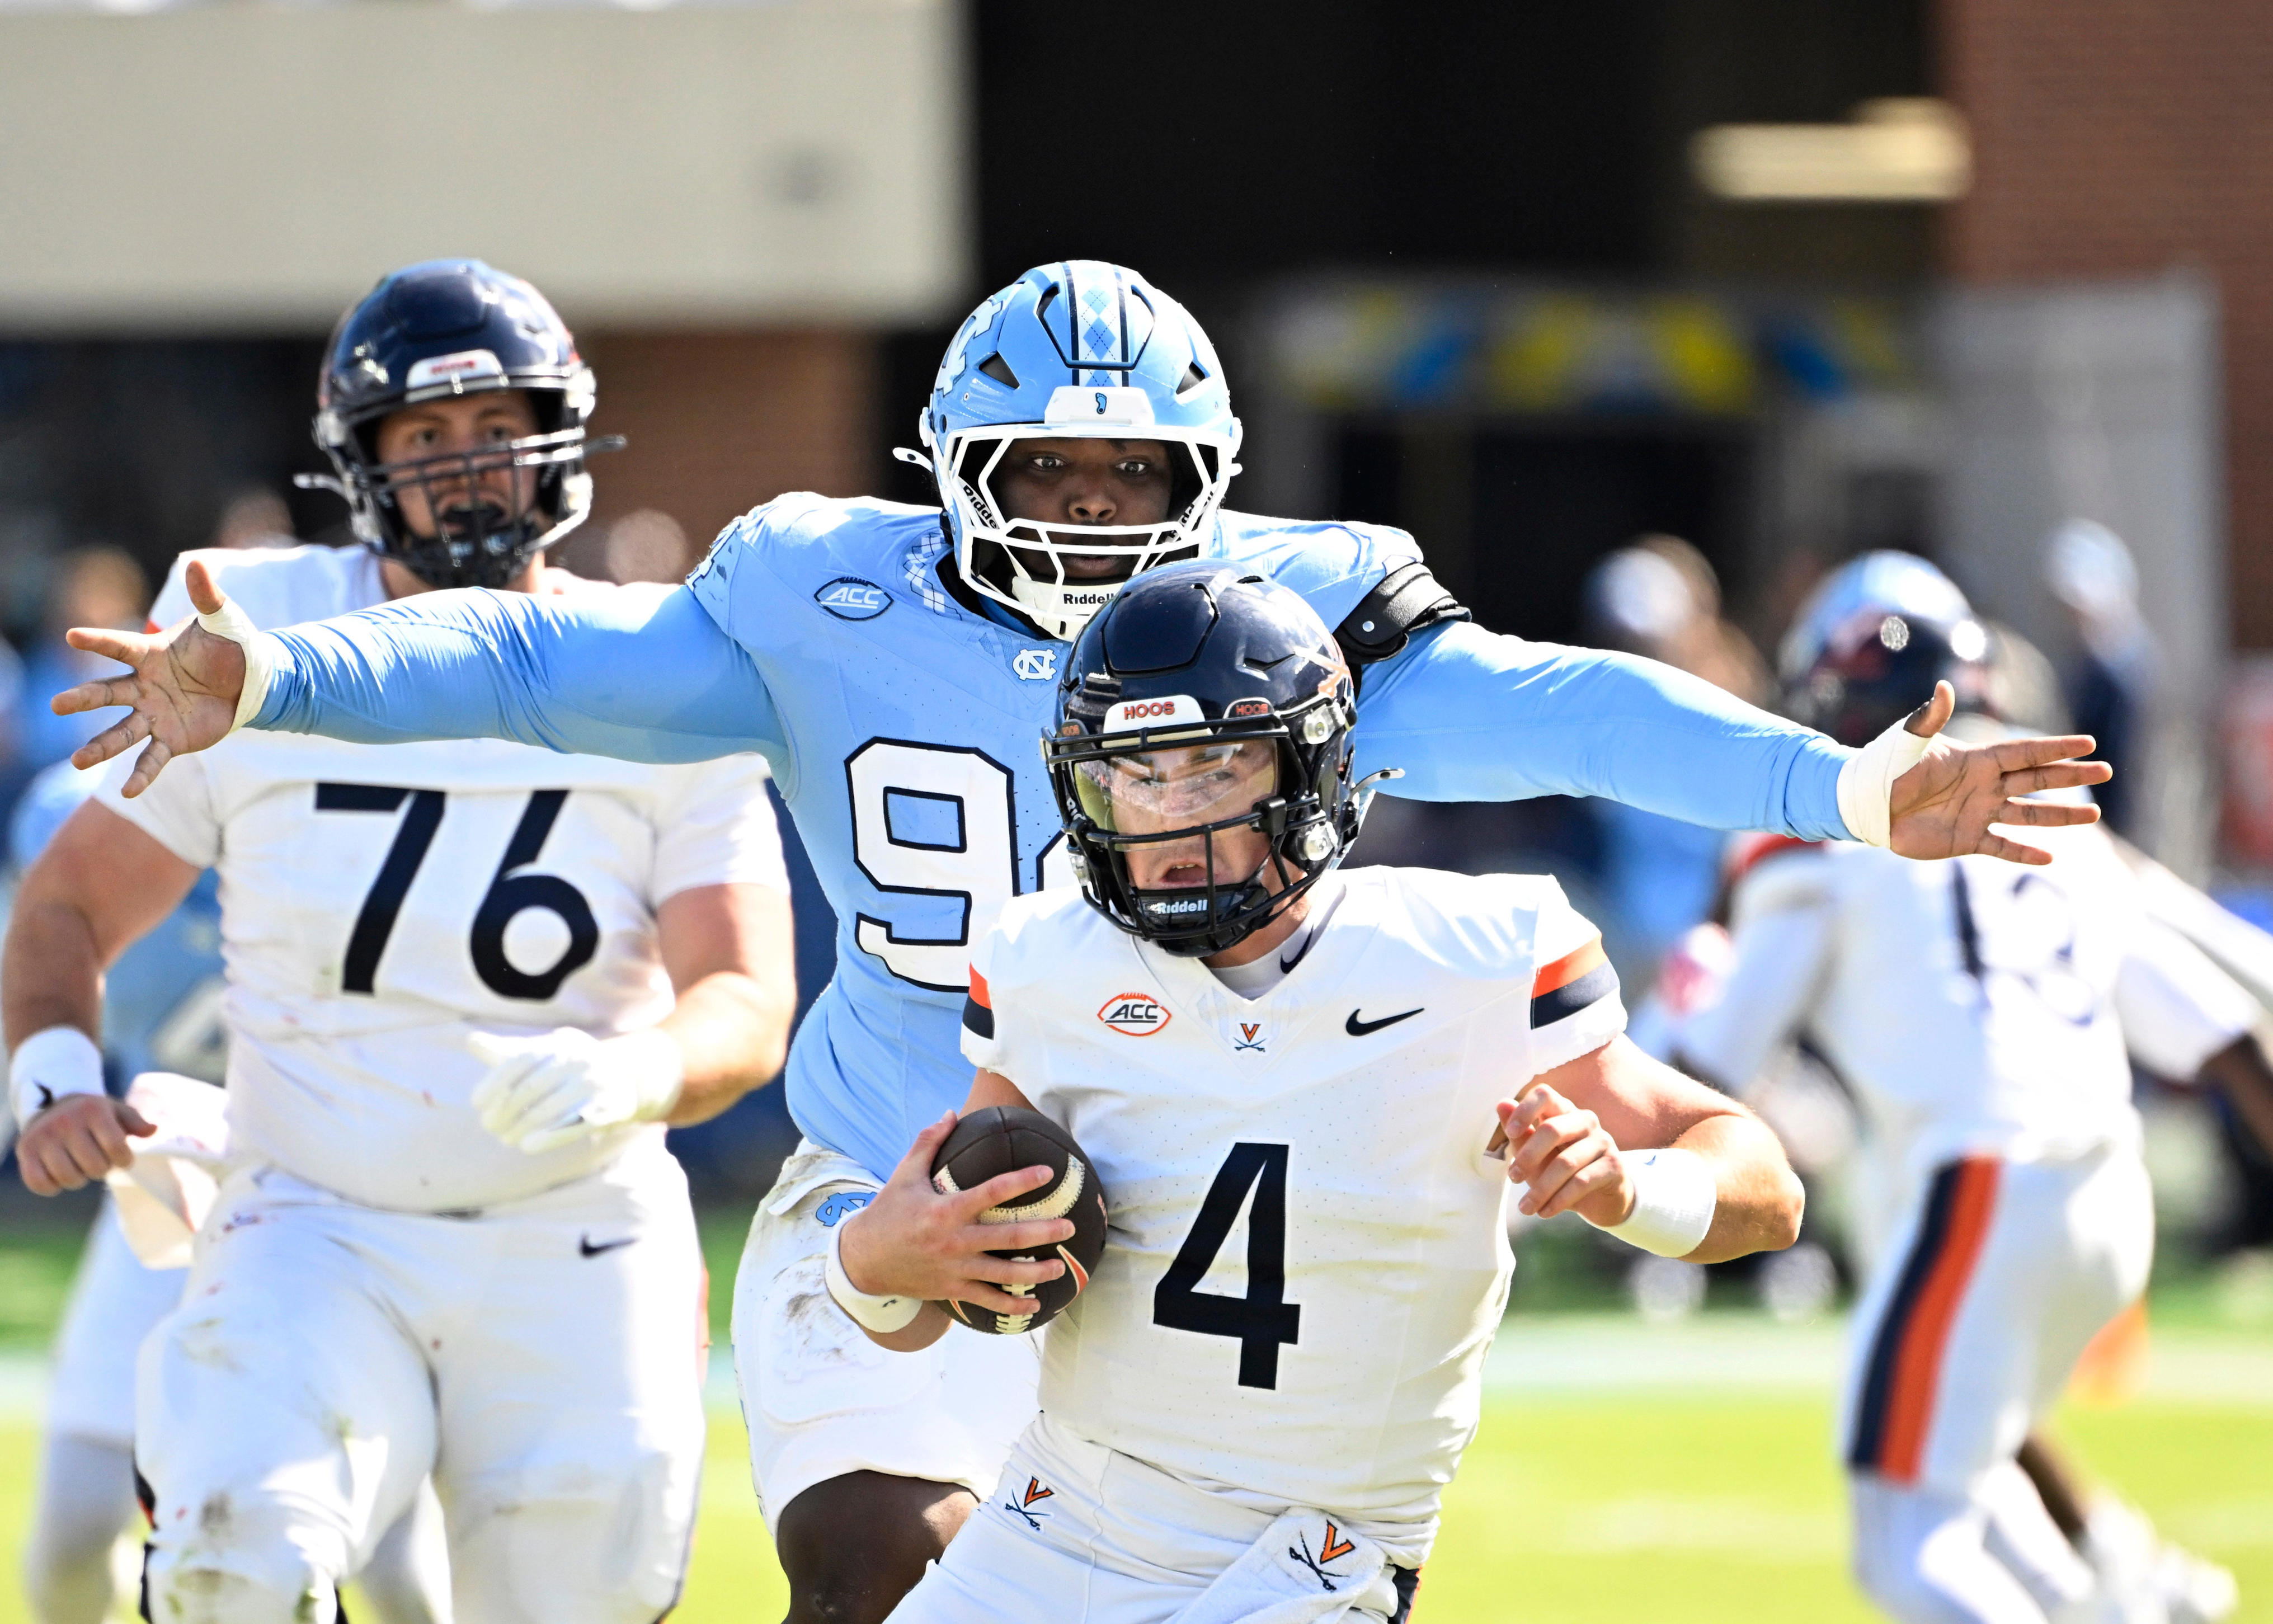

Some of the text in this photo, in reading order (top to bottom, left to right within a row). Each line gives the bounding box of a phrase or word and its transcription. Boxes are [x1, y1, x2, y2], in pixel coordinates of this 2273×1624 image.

[963, 485, 997, 529] Ridde
[825, 587, 883, 605] ACC
[1124, 701, 1175, 720] HOOS
[1236, 703, 1268, 715] HOOS
[844, 736, 1067, 993] 9
[314, 782, 599, 1000] 76
[1156, 900, 1208, 914] Riddell
[1109, 1004, 1158, 1019] ACC
[1239, 1023, 1261, 1043] V
[1154, 1142, 1300, 1390] 4
